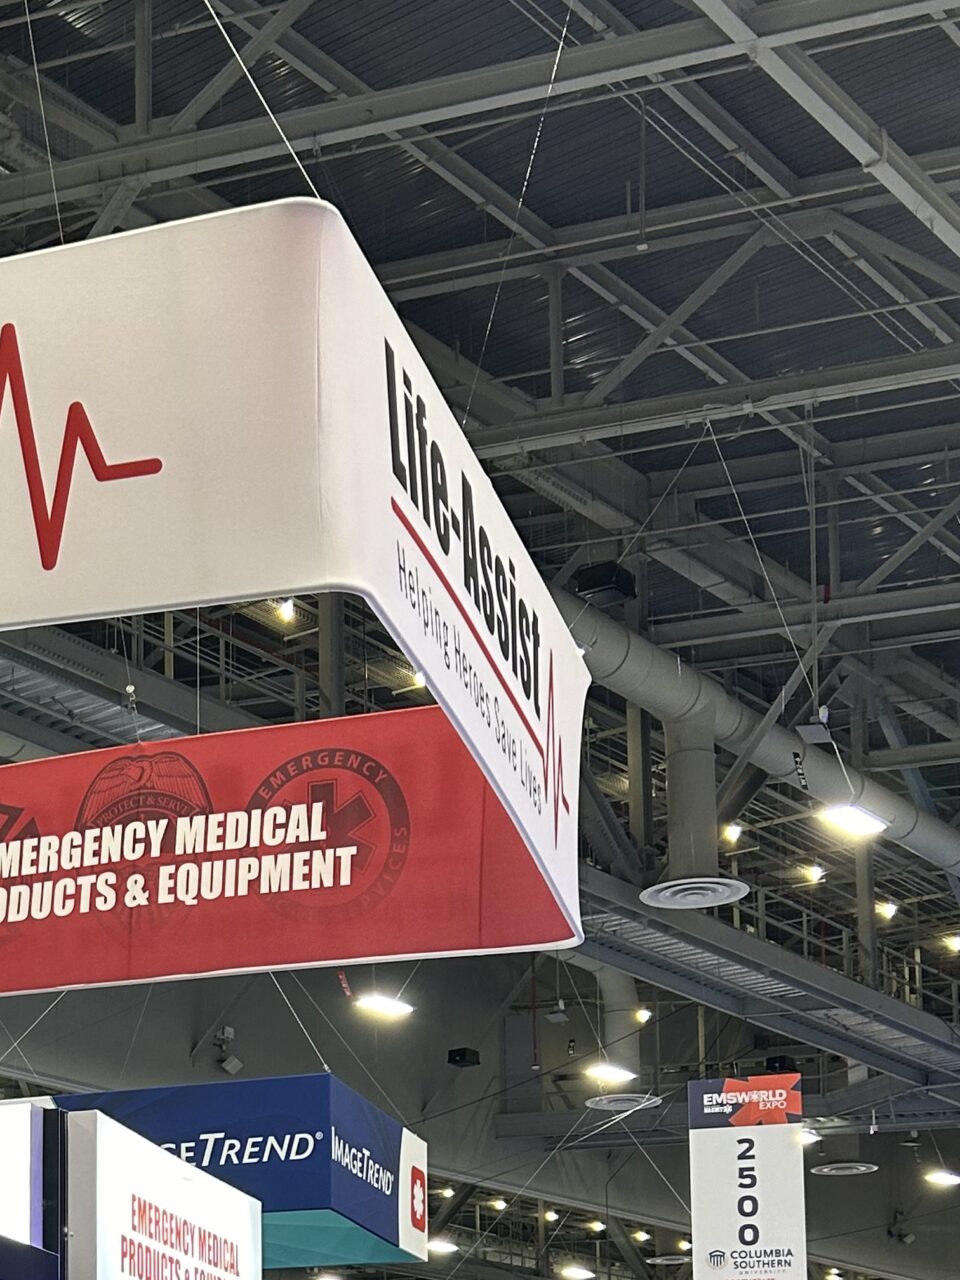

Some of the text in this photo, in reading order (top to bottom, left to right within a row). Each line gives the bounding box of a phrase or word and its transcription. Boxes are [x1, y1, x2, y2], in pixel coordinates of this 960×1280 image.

[384, 337, 540, 721] Life-Assist
[397, 540, 541, 816] Helping Heroes Save Lives
[258, 751, 388, 800] EMERGENCY
[175, 801, 327, 855] MEDICAL
[124, 874, 149, 908] &
[157, 846, 358, 906] EQUIPMENT
[759, 1101, 787, 1110] EXPO
[131, 1193, 240, 1277] EMERGENCY MEDICAL
[730, 1248, 794, 1260] COLUMBIA
[733, 1259, 792, 1270] SOUTHERN
